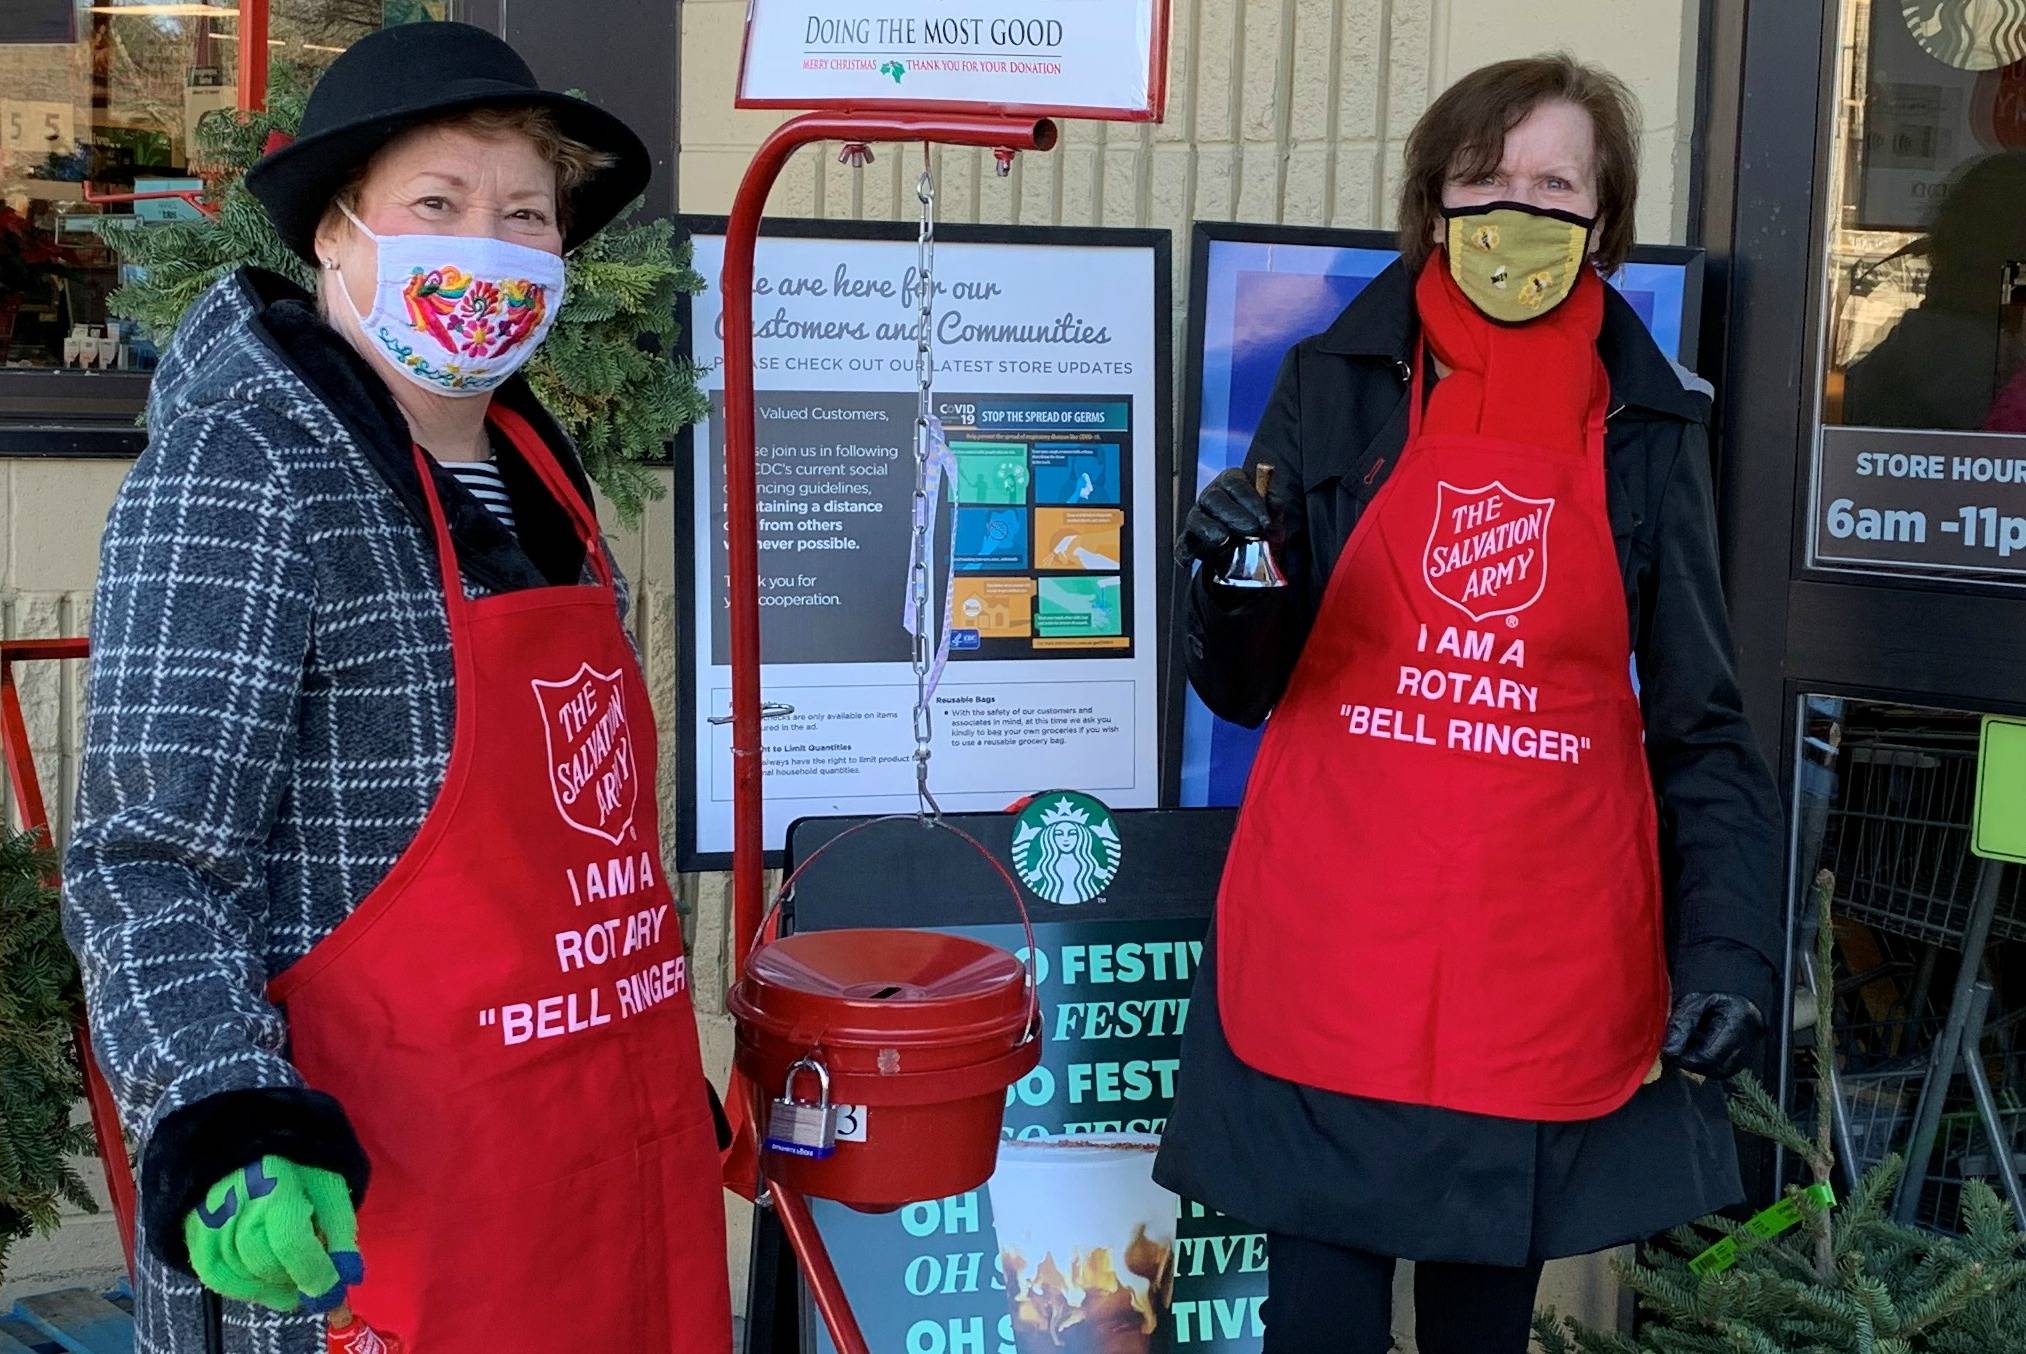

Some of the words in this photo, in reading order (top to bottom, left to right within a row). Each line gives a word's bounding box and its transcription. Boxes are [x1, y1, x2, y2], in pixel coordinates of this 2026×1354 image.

[877, 18, 916, 44] THE
[924, 17, 983, 45] MOST
[990, 18, 1063, 47] GOOD
[803, 59, 828, 70] MERRY
[830, 59, 877, 70] CHRISTMAS
[906, 60, 940, 71] THANK
[941, 60, 960, 72] YOU
[962, 61, 977, 72] FOR
[980, 61, 1007, 73] YOUR
[1010, 62, 1062, 75] DONATION
[778, 277, 828, 297] are
[833, 262, 896, 299] here
[902, 266, 947, 308] for
[952, 281, 1002, 300] our
[715, 307, 870, 341] stomers
[937, 310, 1112, 345] Communities
[714, 356, 779, 370] PSE
[785, 357, 843, 371] CHECK
[848, 359, 884, 371] OUT
[889, 359, 926, 372] OUR
[932, 360, 993, 372] LATEST
[998, 361, 1053, 374] STORE
[1056, 362, 1133, 375] UPDATES
[760, 407, 808, 420] Valued
[811, 407, 889, 422] Customers,
[961, 414, 975, 424] 19
[982, 410, 1005, 422] STOP
[1007, 411, 1023, 422] THE
[1025, 411, 1059, 423] SPREAD
[1061, 411, 1072, 423] OF
[1074, 411, 1105, 423] GERMS
[771, 444, 797, 459] join
[800, 446, 817, 457] us
[820, 444, 832, 457] in
[836, 444, 898, 461] following
[795, 464, 846, 476] current
[849, 463, 888, 475] social
[1856, 452, 1945, 480] STORE
[799, 482, 872, 497] guidelines,
[811, 504, 820, 513] a
[824, 500, 883, 513] distance
[1452, 494, 1503, 534] THE
[760, 518, 793, 531] from
[797, 518, 843, 531] others
[1827, 498, 1927, 543] 6am
[797, 536, 860, 552] possible.
[1430, 508, 1542, 577] SALVATION
[769, 577, 794, 589] you
[798, 574, 817, 588] for
[1461, 548, 1534, 602] ARMY
[1417, 624, 1428, 652] I
[1436, 626, 1495, 662] AM
[1499, 638, 1525, 668] A
[1396, 666, 1538, 712] ROTARY
[975, 696, 995, 704] Bags
[559, 680, 597, 743] THE
[807, 713, 824, 721] only
[827, 712, 862, 720] available
[952, 708, 970, 716] With
[972, 708, 984, 716] the
[987, 707, 1009, 716] safety
[1002, 718, 1023, 726] mind,
[952, 729, 974, 737] kindly
[987, 728, 1001, 736] bag
[1041, 727, 1077, 735] groceries
[808, 743, 852, 752] Quantities
[984, 738, 1016, 746] reusable
[1018, 738, 1048, 746] grocery
[791, 757, 810, 765] have
[812, 757, 826, 765] the
[828, 757, 847, 765] right
[878, 755, 909, 763] product
[595, 737, 629, 826] ARMY
[776, 768, 817, 776] household
[566, 868, 581, 907] I
[587, 855, 635, 903] AM
[640, 851, 654, 890] A
[555, 904, 668, 973] ROTARY
[1052, 999, 1190, 1041] FESTI
[1067, 1059, 1180, 1103] FEST
[837, 1104, 858, 1135] 3
[901, 1191, 979, 1237] OH
[905, 1252, 984, 1296] OH
[906, 1316, 986, 1354] OH
